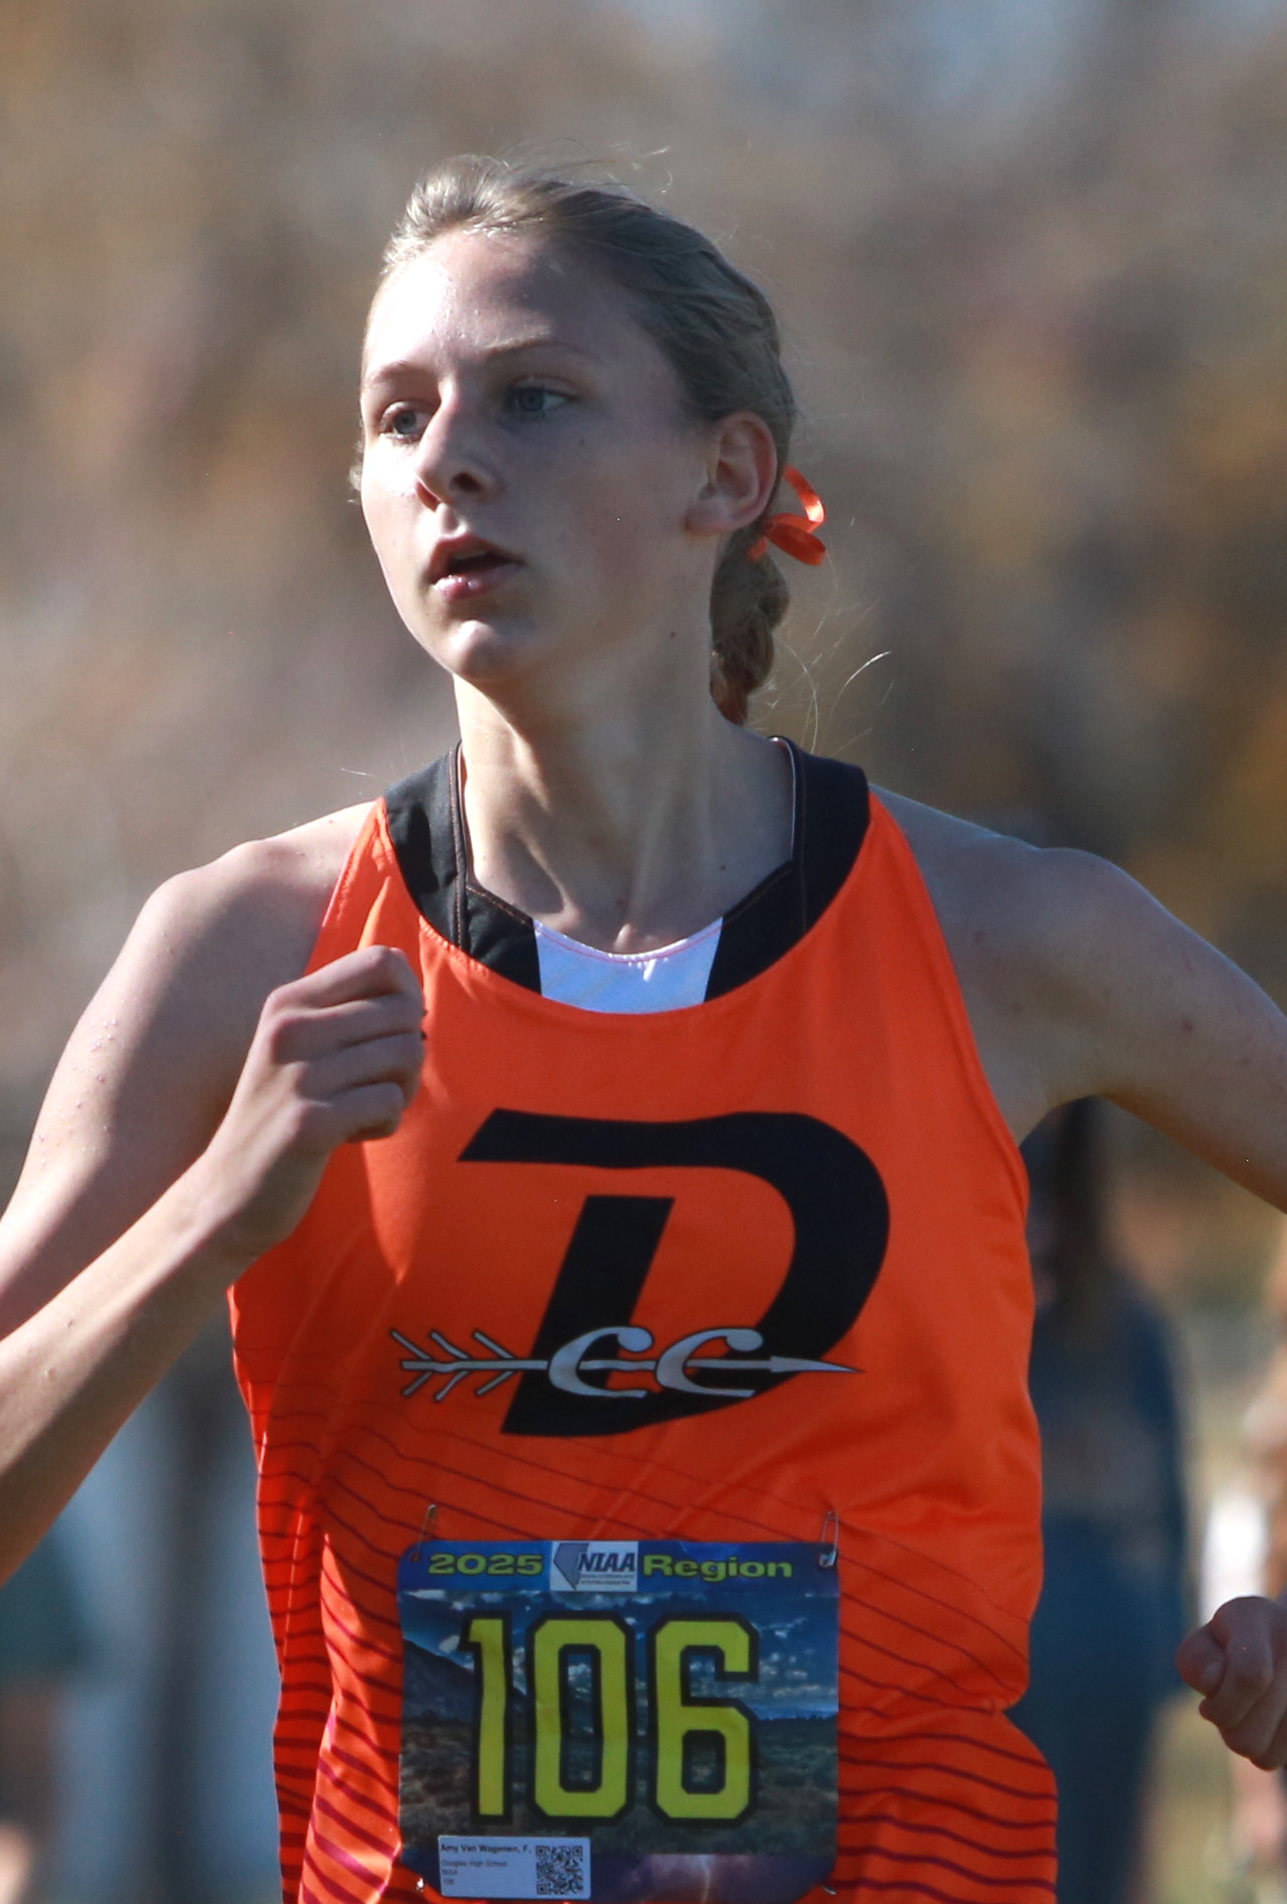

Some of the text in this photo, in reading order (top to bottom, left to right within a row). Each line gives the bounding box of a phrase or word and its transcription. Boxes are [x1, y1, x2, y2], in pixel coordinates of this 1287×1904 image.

[457, 1107, 891, 1437] D
[427, 1552, 793, 1582] 2025 NIAA Region
[463, 1614, 755, 1823] 106
